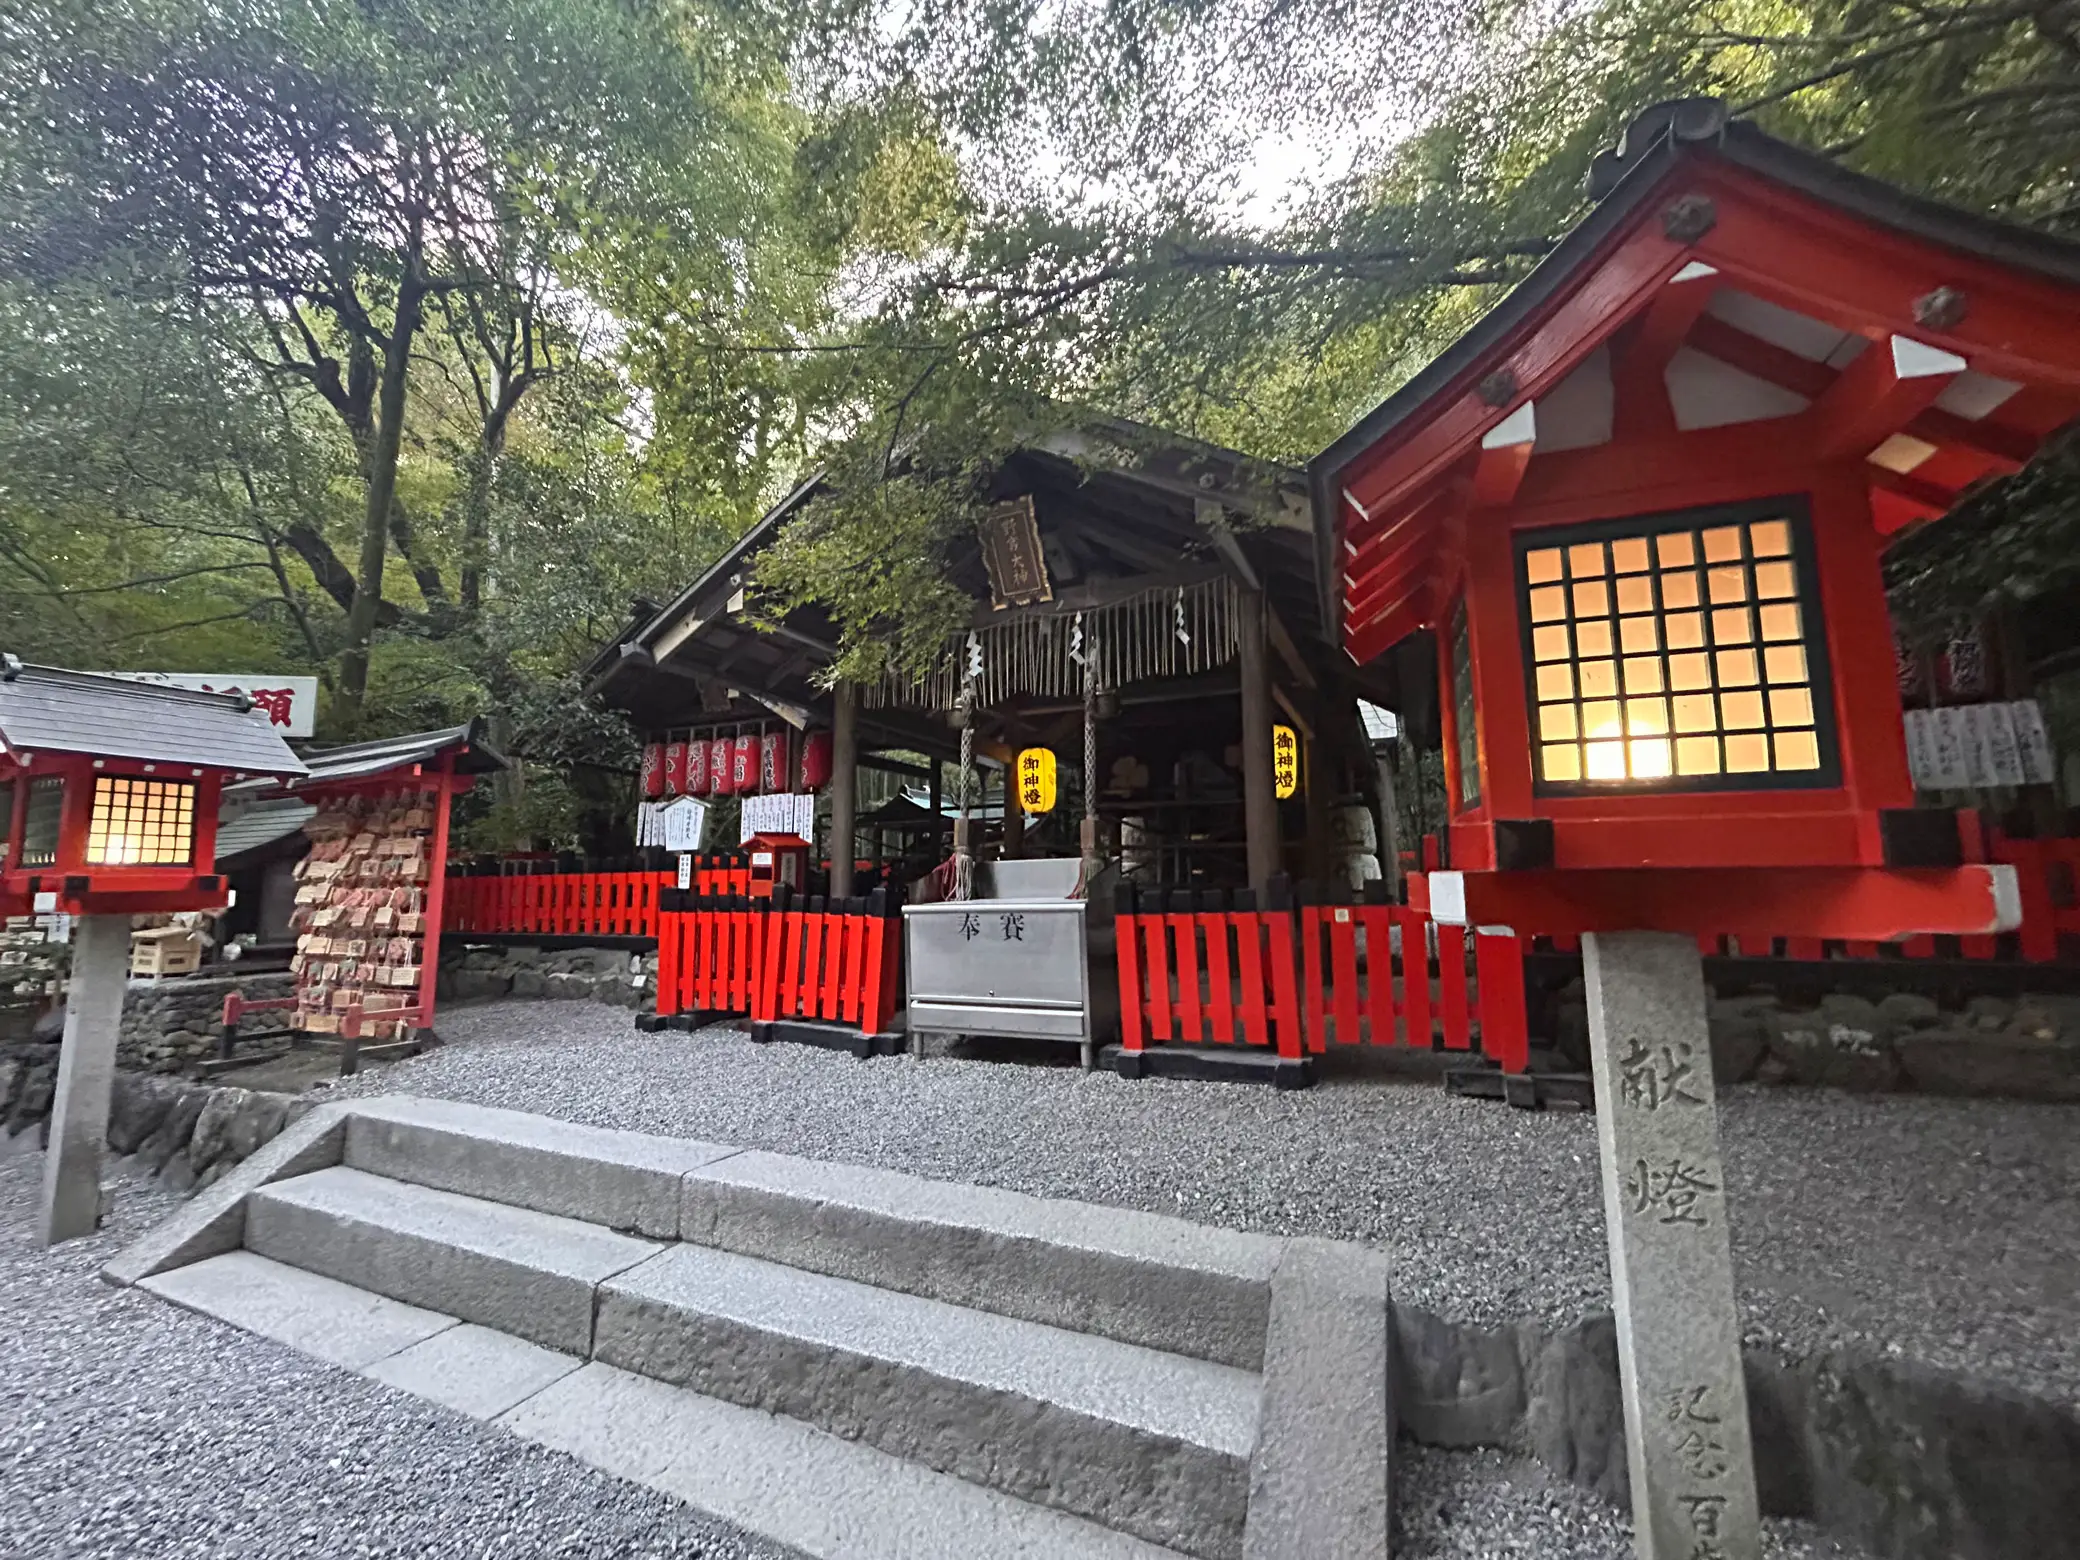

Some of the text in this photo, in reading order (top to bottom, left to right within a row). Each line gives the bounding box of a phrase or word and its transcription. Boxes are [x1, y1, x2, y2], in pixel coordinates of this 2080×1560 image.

[1022, 754, 1042, 806] 御神燈
[1274, 731, 1294, 789] 御神燈
